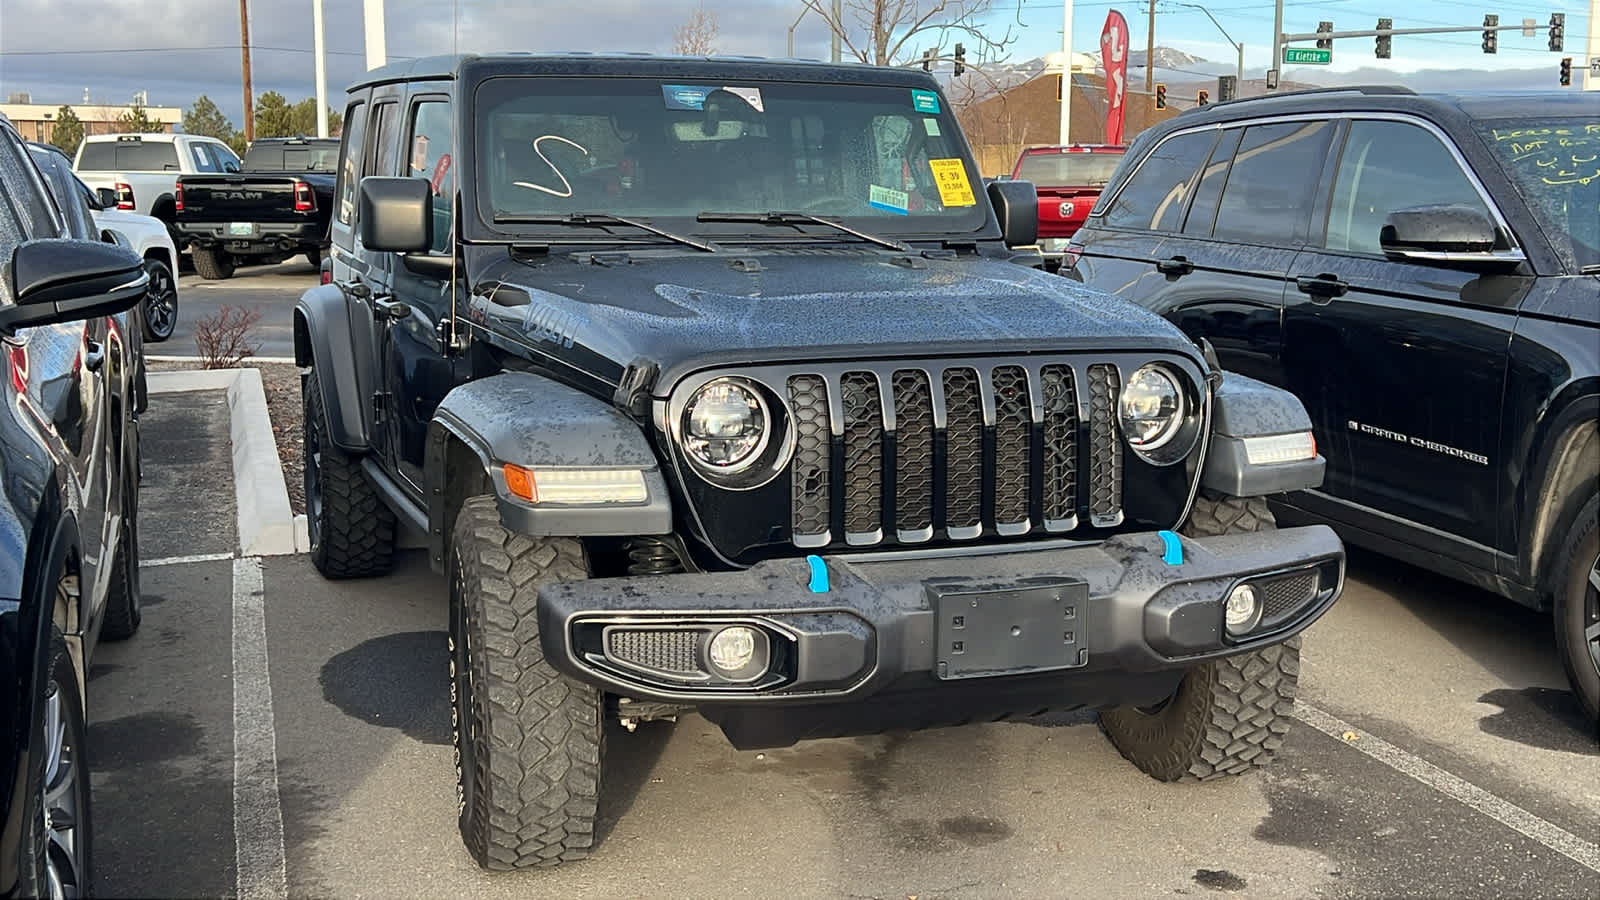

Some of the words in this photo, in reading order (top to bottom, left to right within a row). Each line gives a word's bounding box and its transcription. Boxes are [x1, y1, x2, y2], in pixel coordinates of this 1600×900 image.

[1295, 50, 1321, 62] Kietzke
[210, 191, 263, 200] RAM
[1360, 423, 1407, 443] GRAND
[1409, 437, 1489, 465] CHEROKEE
